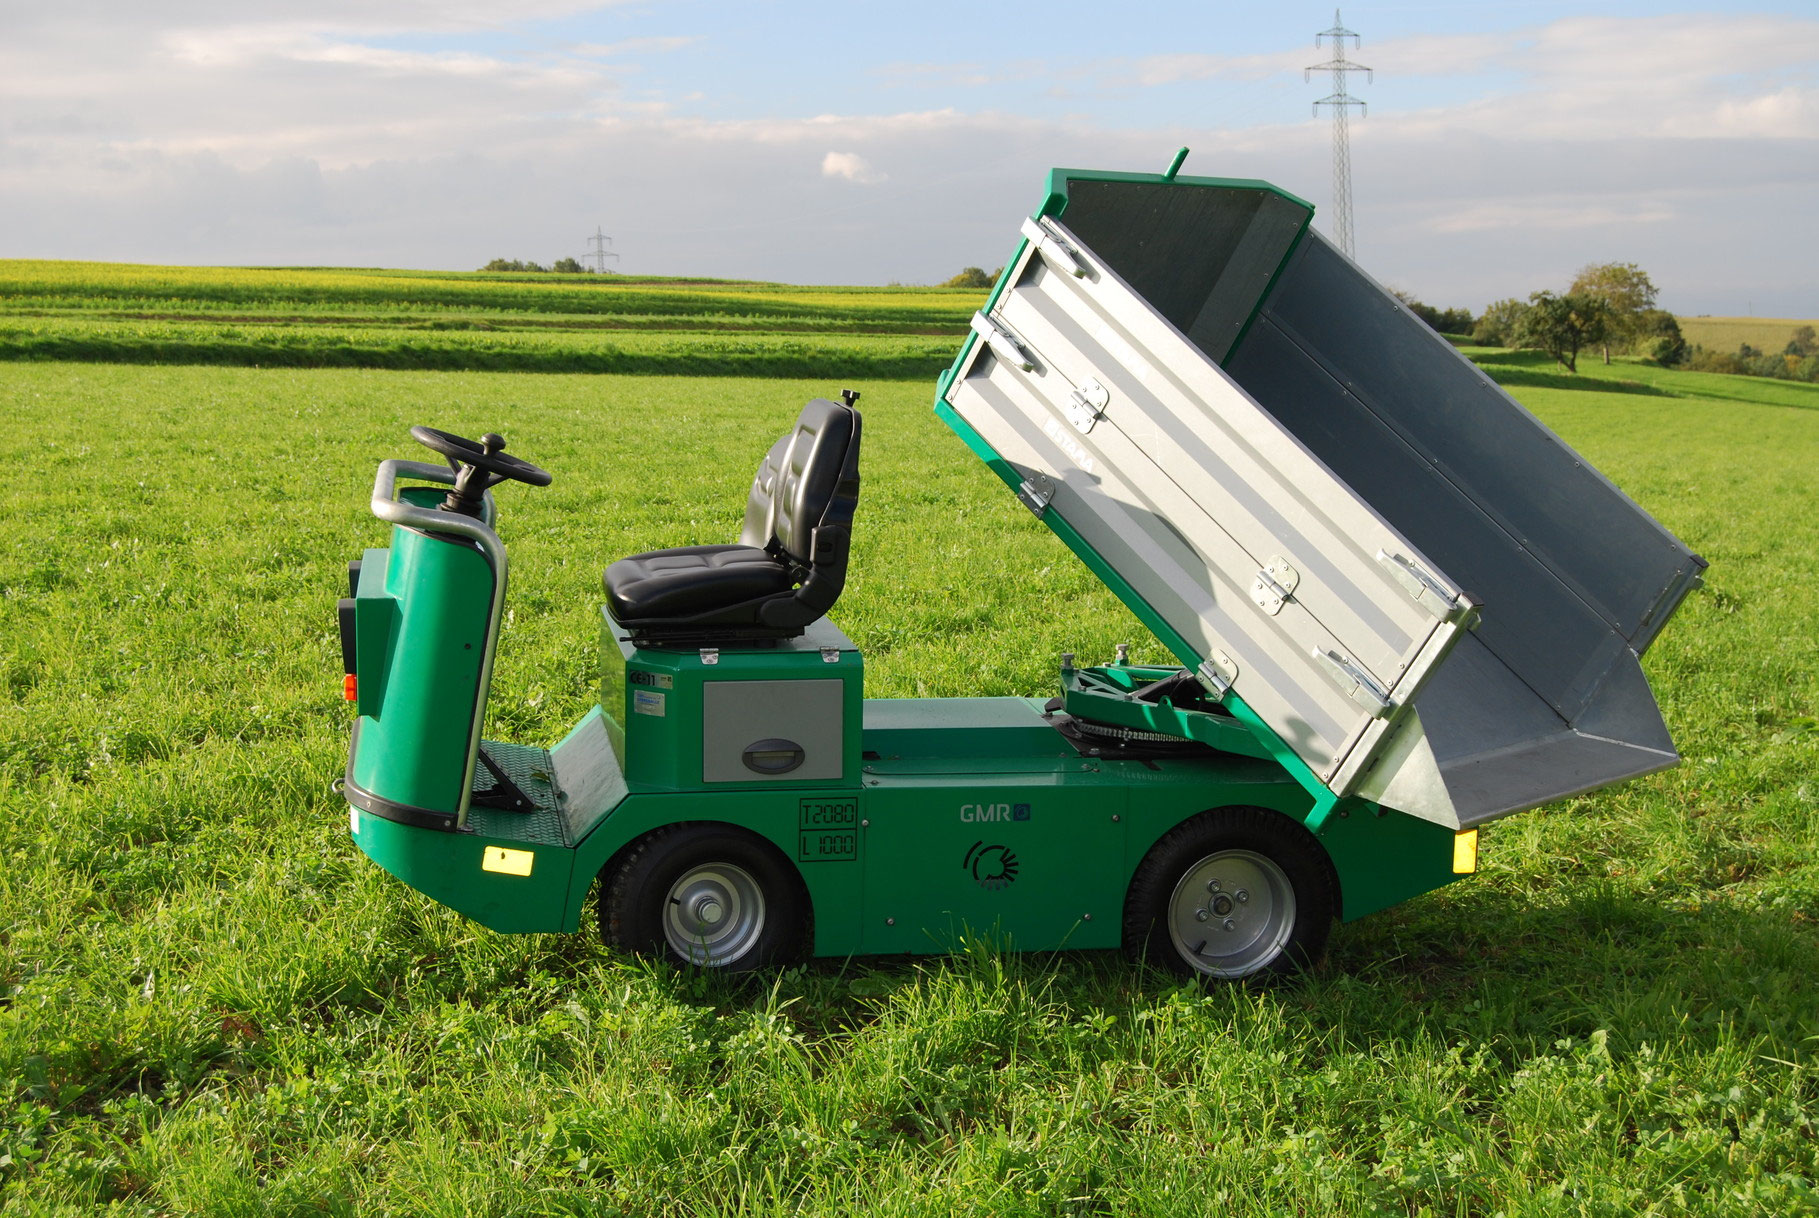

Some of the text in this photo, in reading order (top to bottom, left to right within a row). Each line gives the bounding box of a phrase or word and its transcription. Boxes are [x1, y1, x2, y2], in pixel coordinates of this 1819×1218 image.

[802, 804, 855, 824] T2080
[960, 804, 1011, 822] GMR
[803, 835, 854, 855] L 1000
